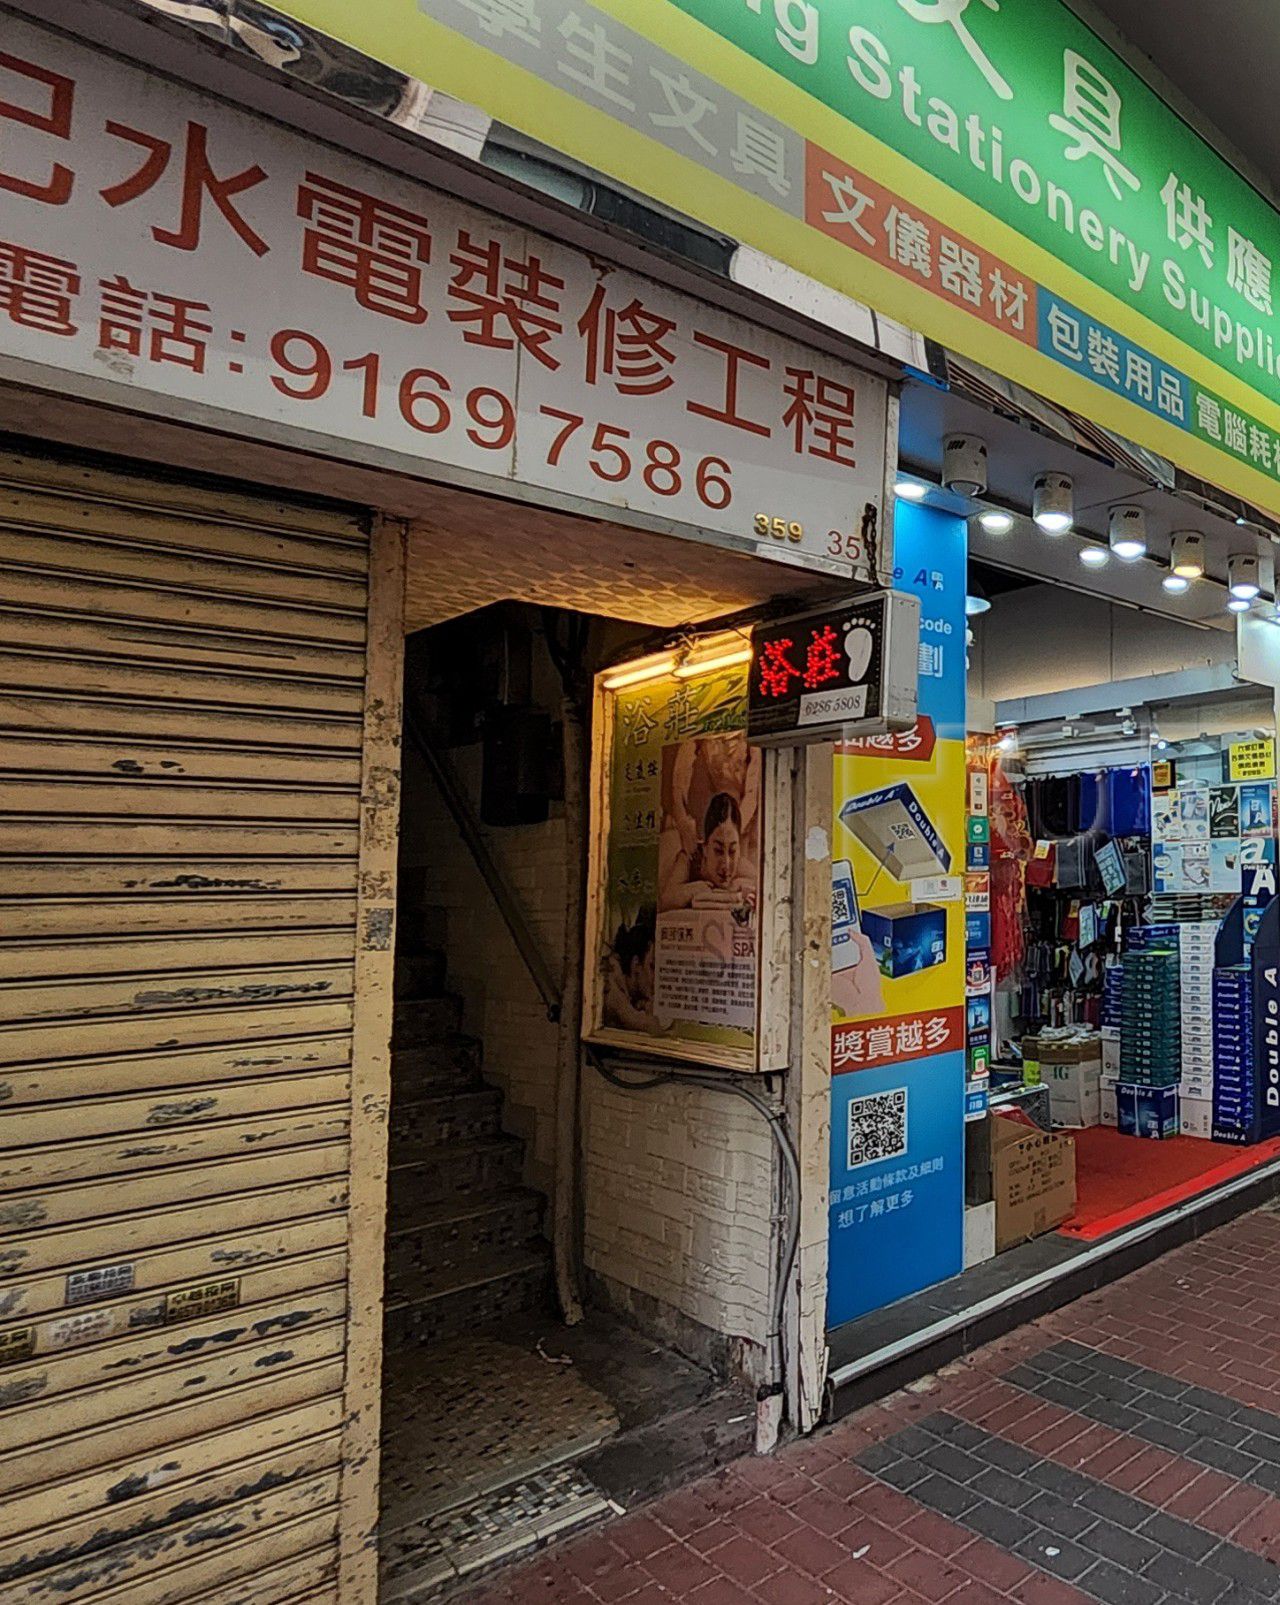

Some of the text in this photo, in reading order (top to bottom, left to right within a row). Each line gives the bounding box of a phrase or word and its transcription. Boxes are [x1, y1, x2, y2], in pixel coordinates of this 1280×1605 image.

[846, 25, 1149, 292] Stationery
[821, 170, 1028, 331] 文儀器材
[1048, 302, 1185, 421] 包裝用品
[754, 512, 803, 545] 359
[834, 1017, 950, 1067] 獎賞越多
[1264, 967, 1280, 1107] Double A
[838, 1190, 915, 1229] 想了解更多
